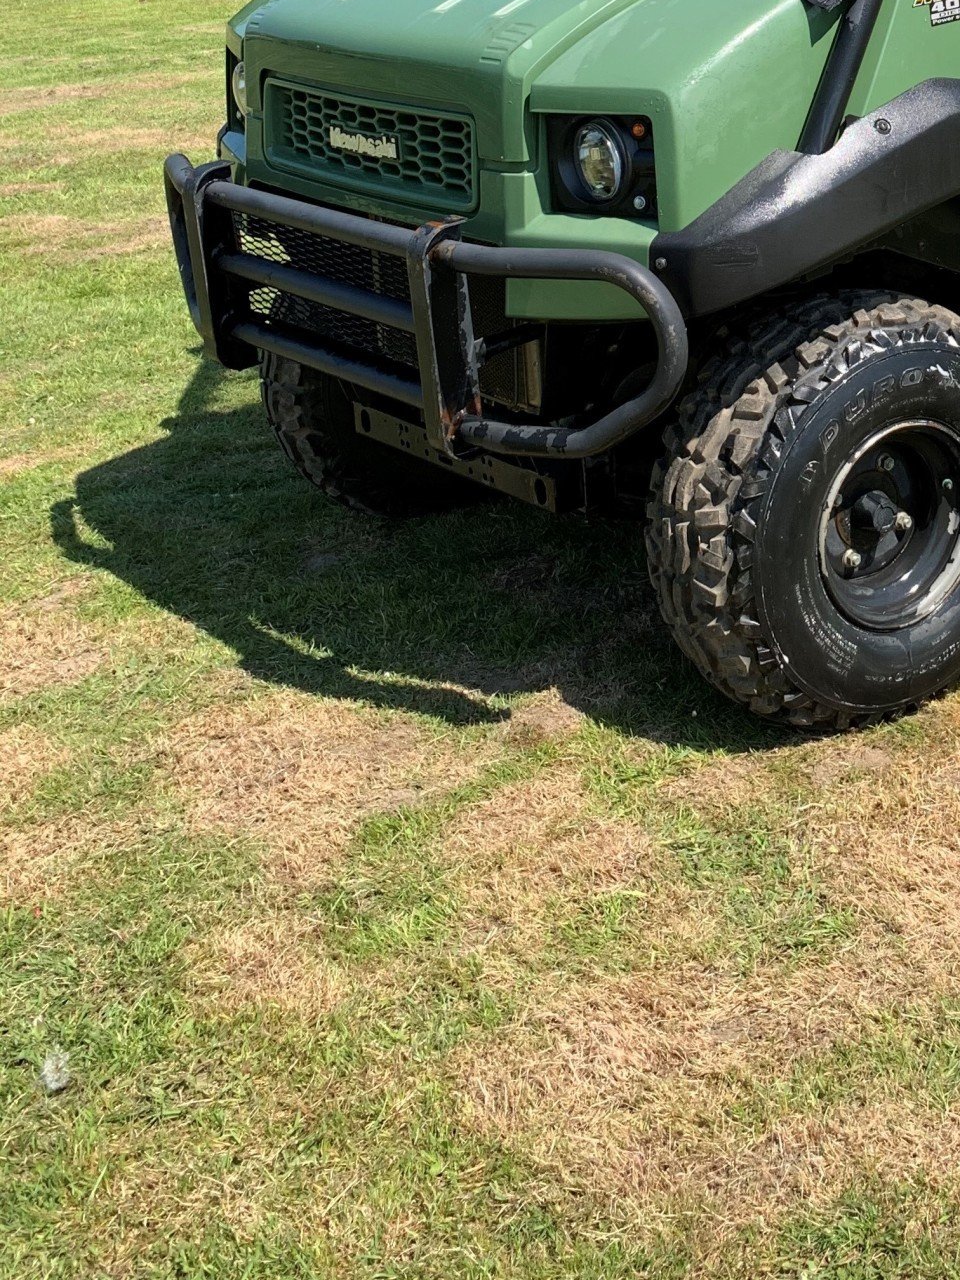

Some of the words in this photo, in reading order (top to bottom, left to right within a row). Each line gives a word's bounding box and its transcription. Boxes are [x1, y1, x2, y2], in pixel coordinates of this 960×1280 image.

[932, 15, 954, 25] Power
[330, 126, 397, 158] Kawasaki
[818, 367, 924, 455] DURO
